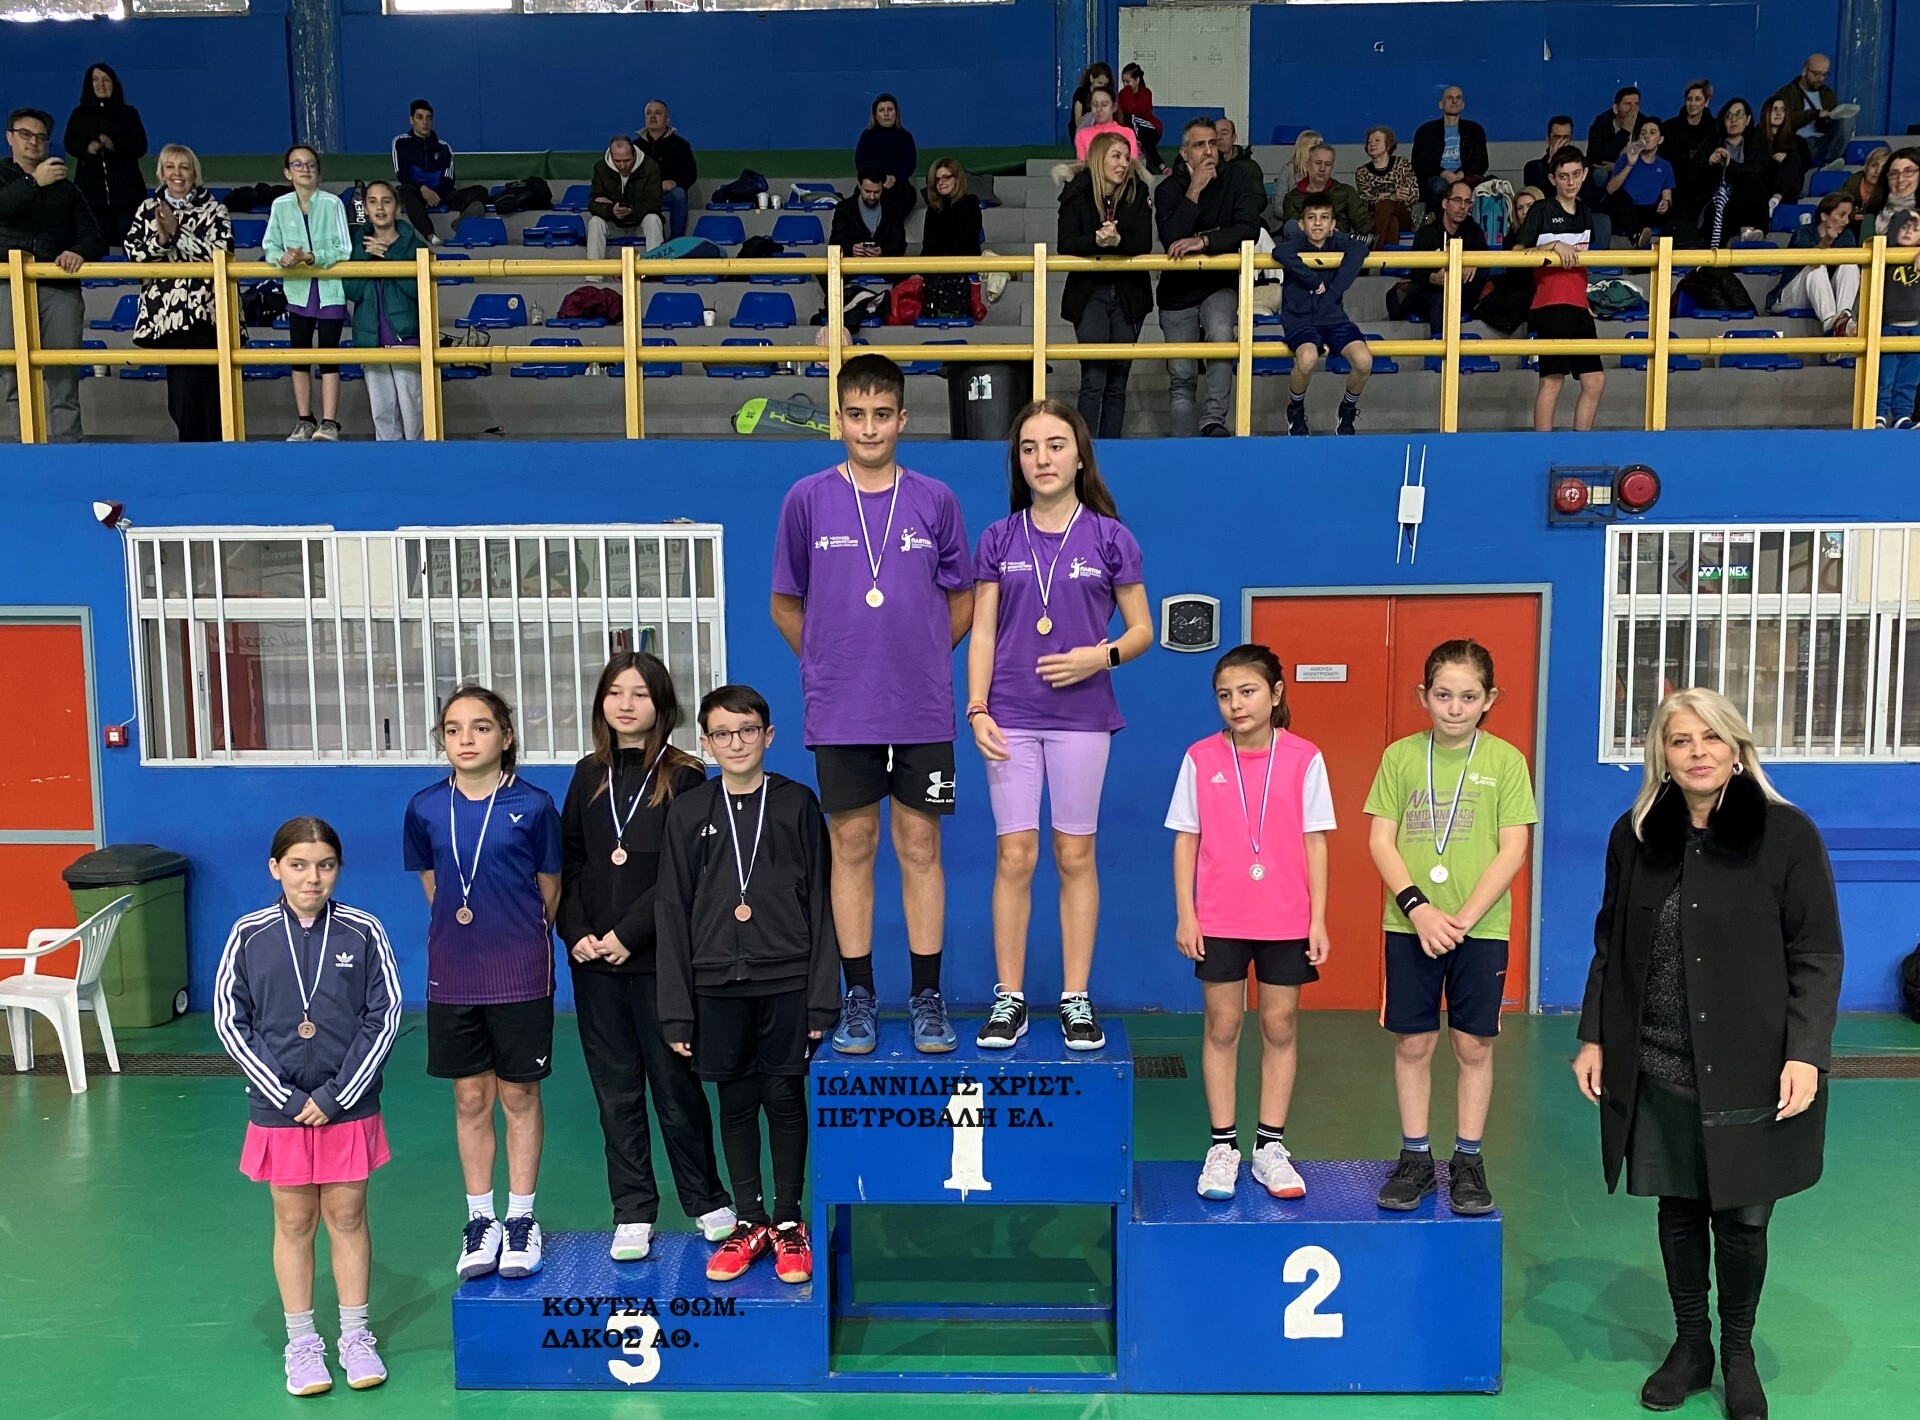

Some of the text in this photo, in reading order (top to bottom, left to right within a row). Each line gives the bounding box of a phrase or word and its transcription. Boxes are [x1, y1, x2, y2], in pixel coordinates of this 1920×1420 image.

[1717, 566, 1748, 576] YNEX
[1283, 1245, 1343, 1339] 2
[606, 1309, 661, 1384] 3
